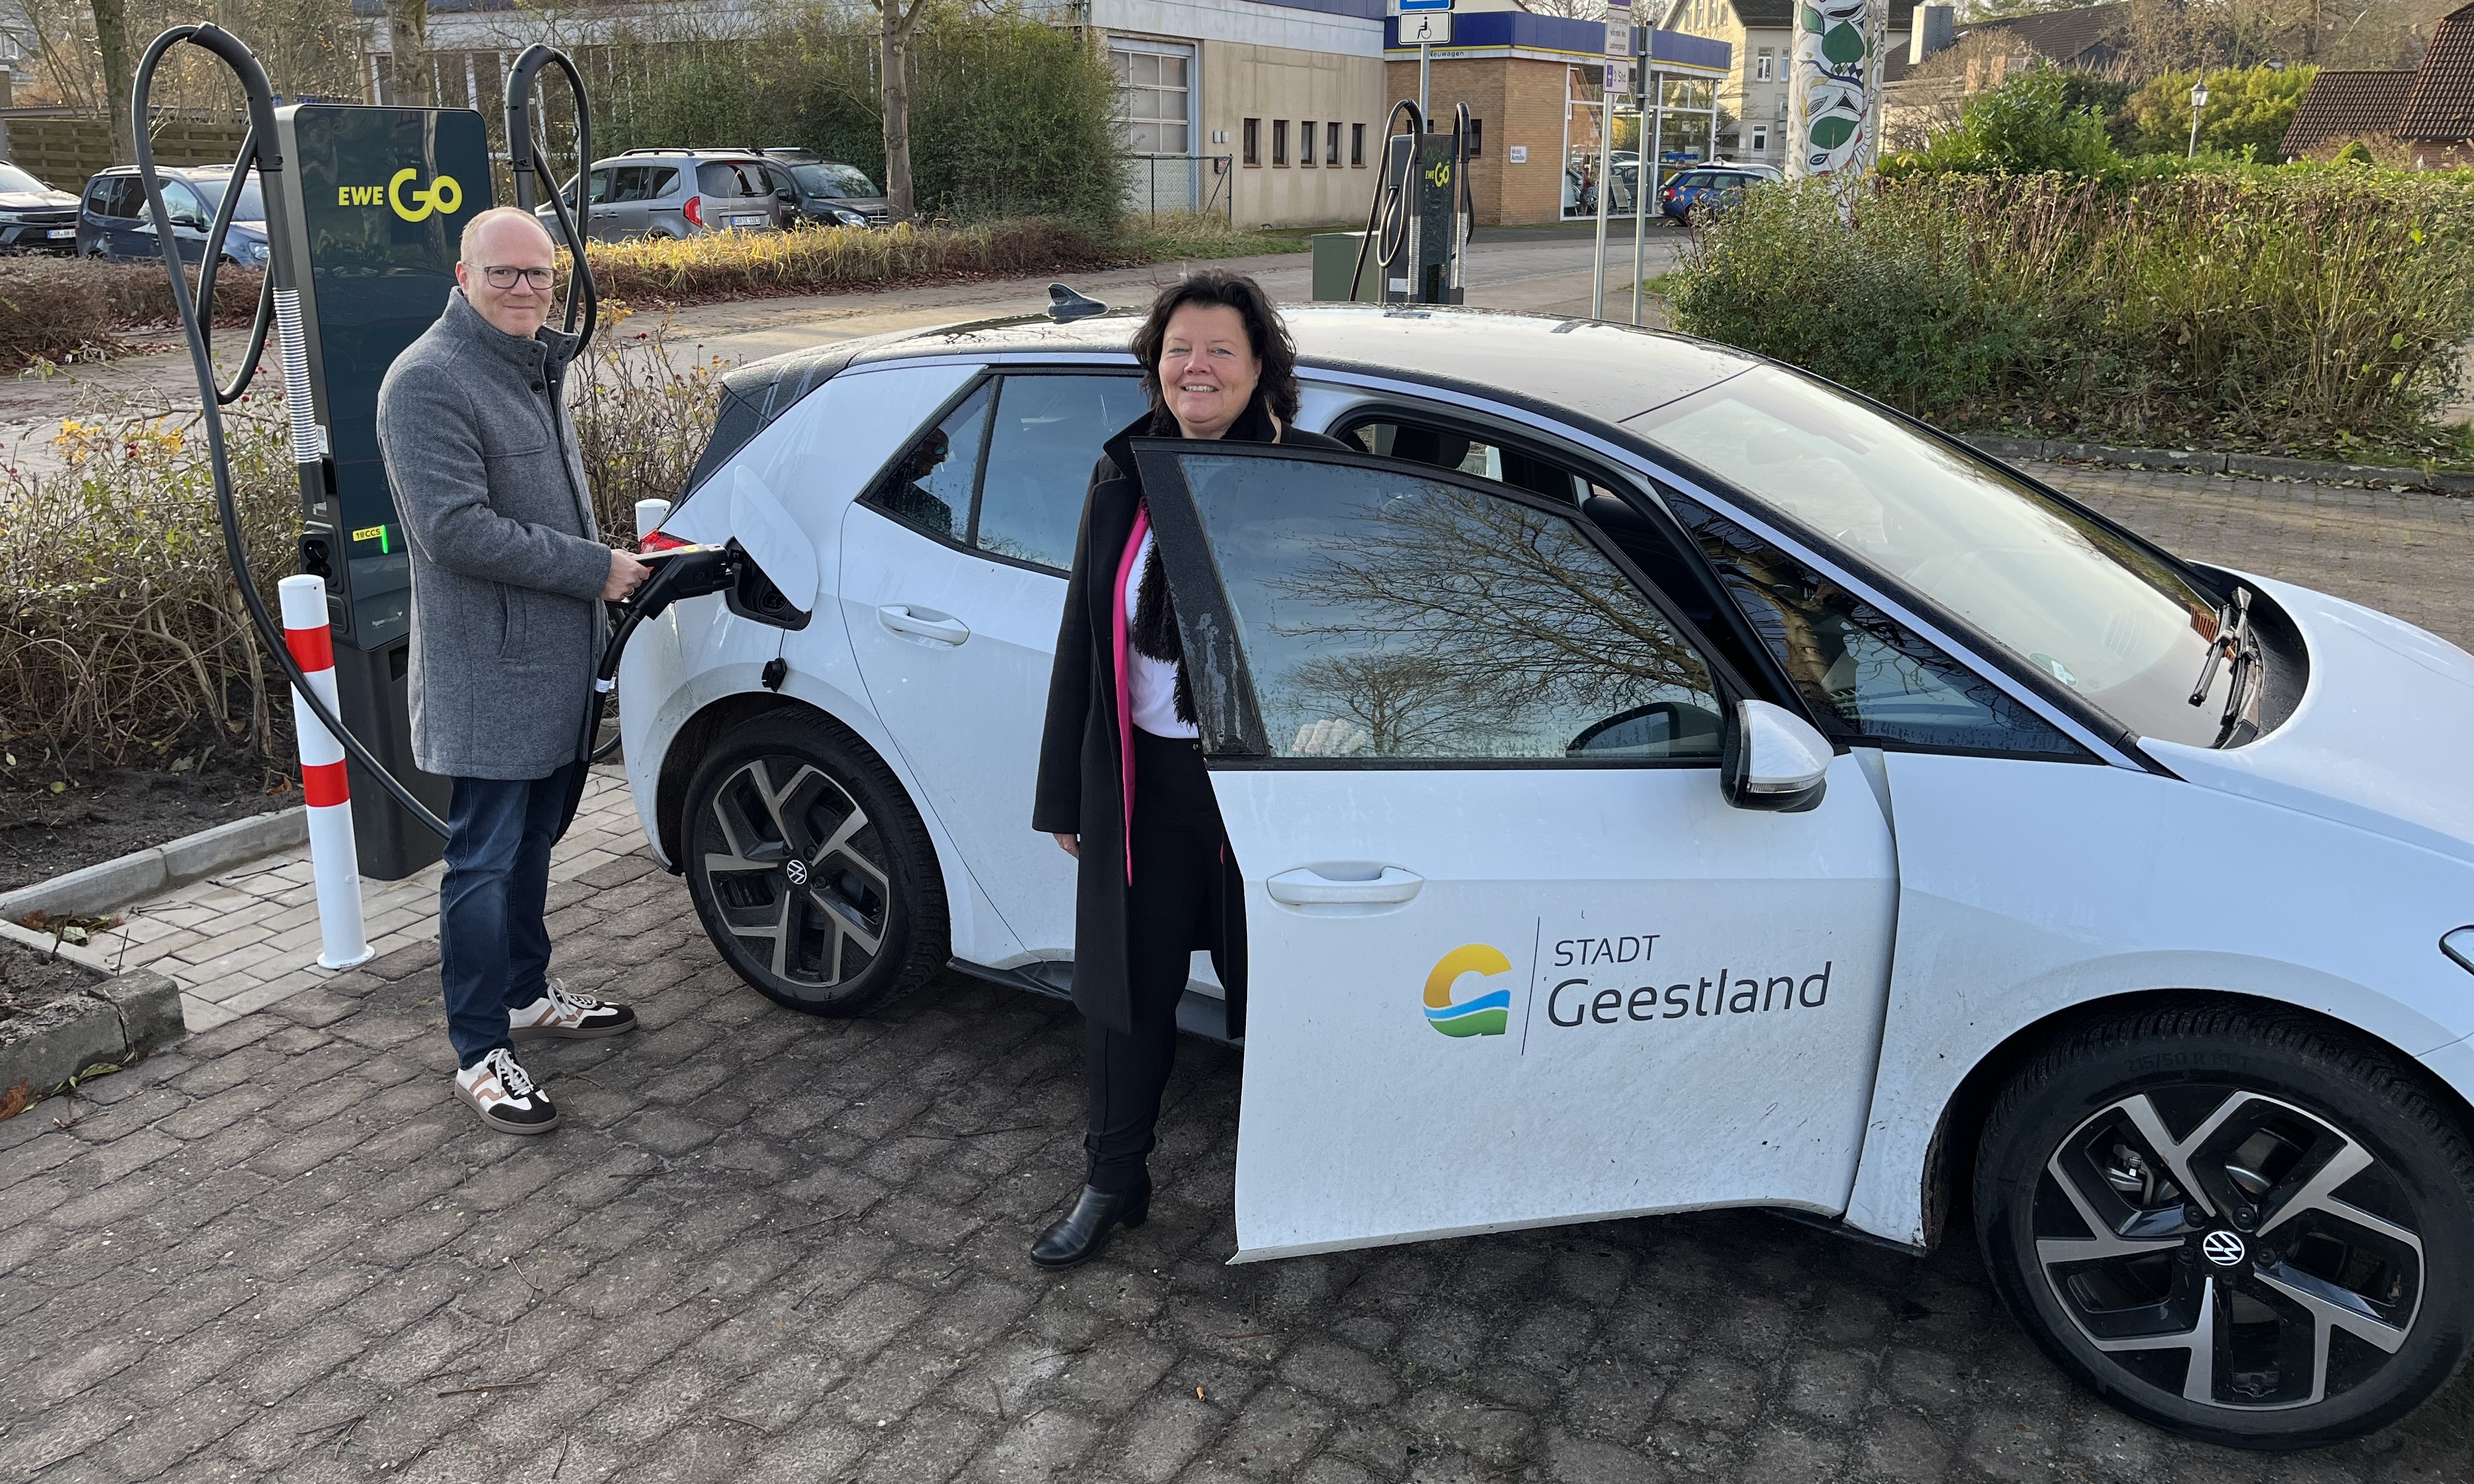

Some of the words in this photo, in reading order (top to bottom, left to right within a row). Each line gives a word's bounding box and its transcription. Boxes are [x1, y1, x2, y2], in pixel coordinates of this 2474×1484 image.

[1559, 54, 1590, 62] Gebrauchtwagen
[1613, 70, 1617, 82] 3
[1425, 170, 1435, 179] EWE
[339, 186, 384, 206] EWE
[365, 529, 380, 537] CCS
[1555, 934, 1661, 967] STADT
[1547, 960, 1832, 1028] Geestland
